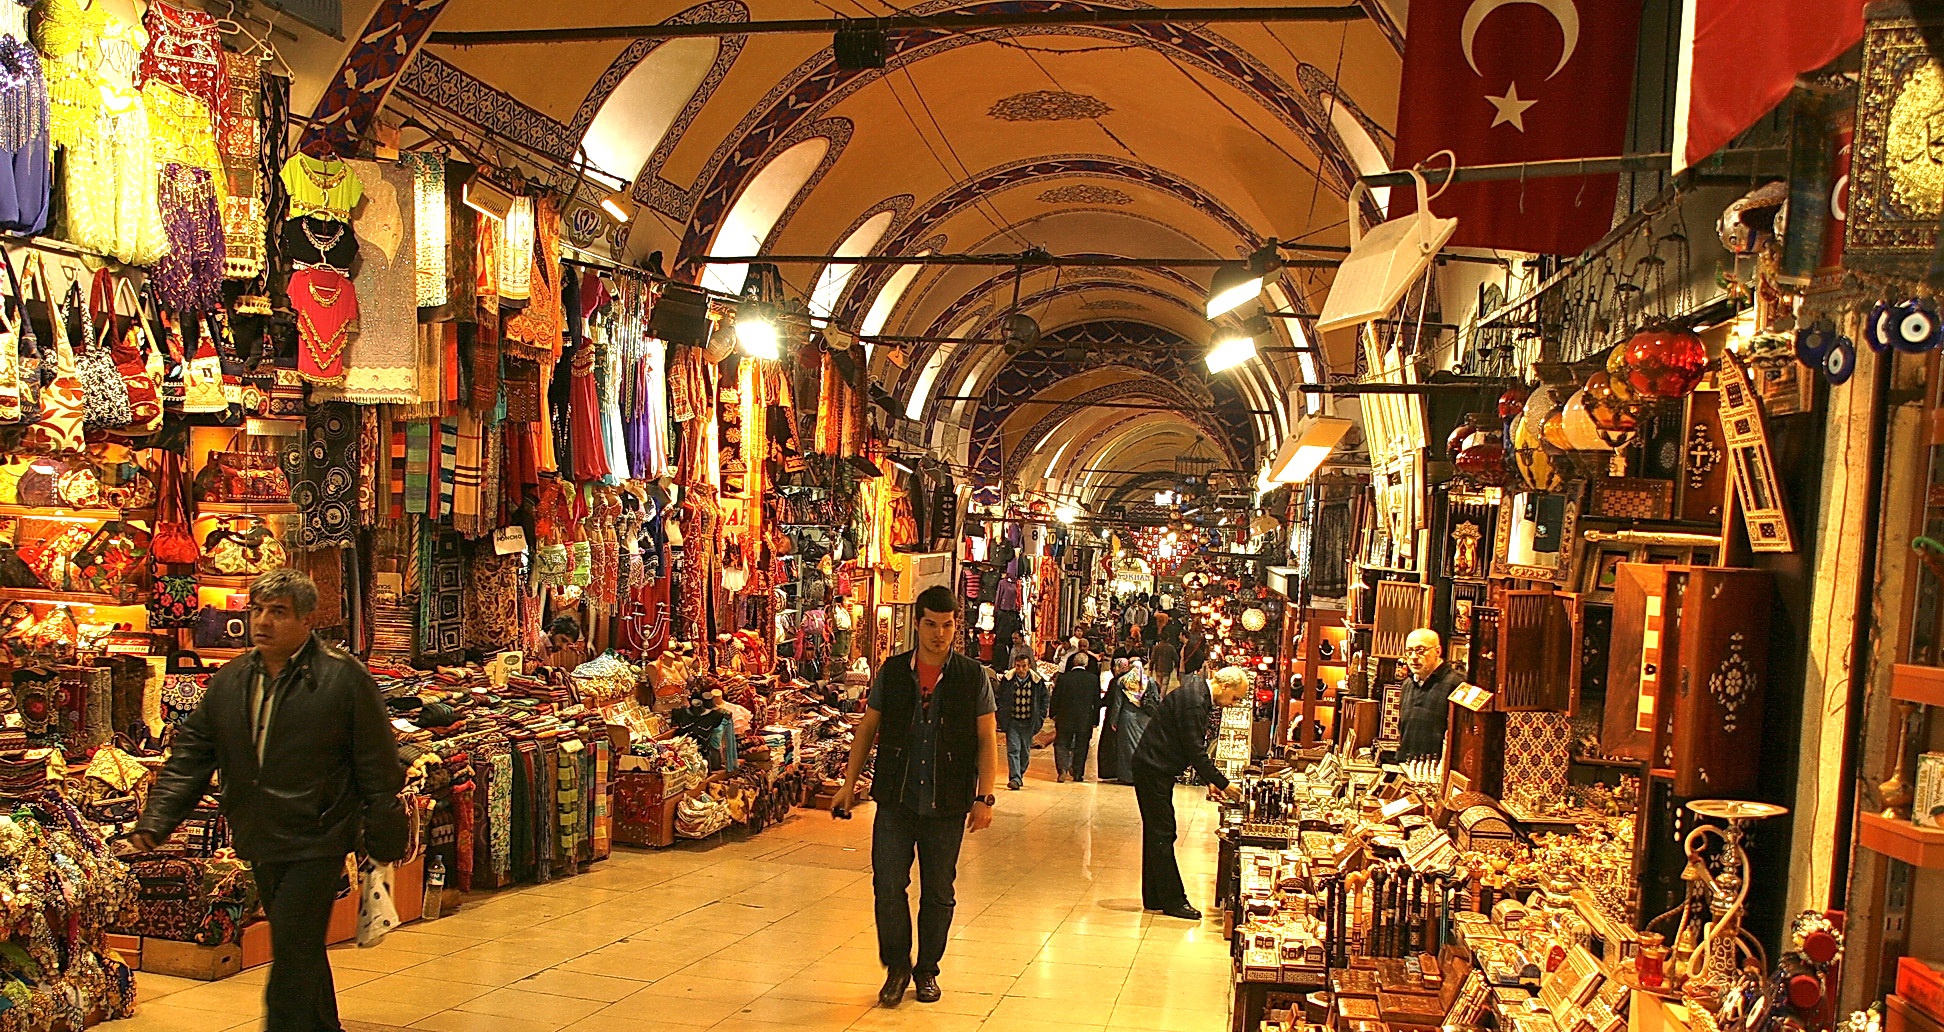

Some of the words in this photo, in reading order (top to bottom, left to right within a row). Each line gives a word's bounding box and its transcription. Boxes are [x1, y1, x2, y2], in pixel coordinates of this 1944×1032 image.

[496, 534, 523, 542] PONCHO
[1032, 530, 1038, 541] 8
[1047, 532, 1056, 545] 10
[1919, 769, 1928, 783] TEA
[1916, 785, 1926, 813] LEMON
